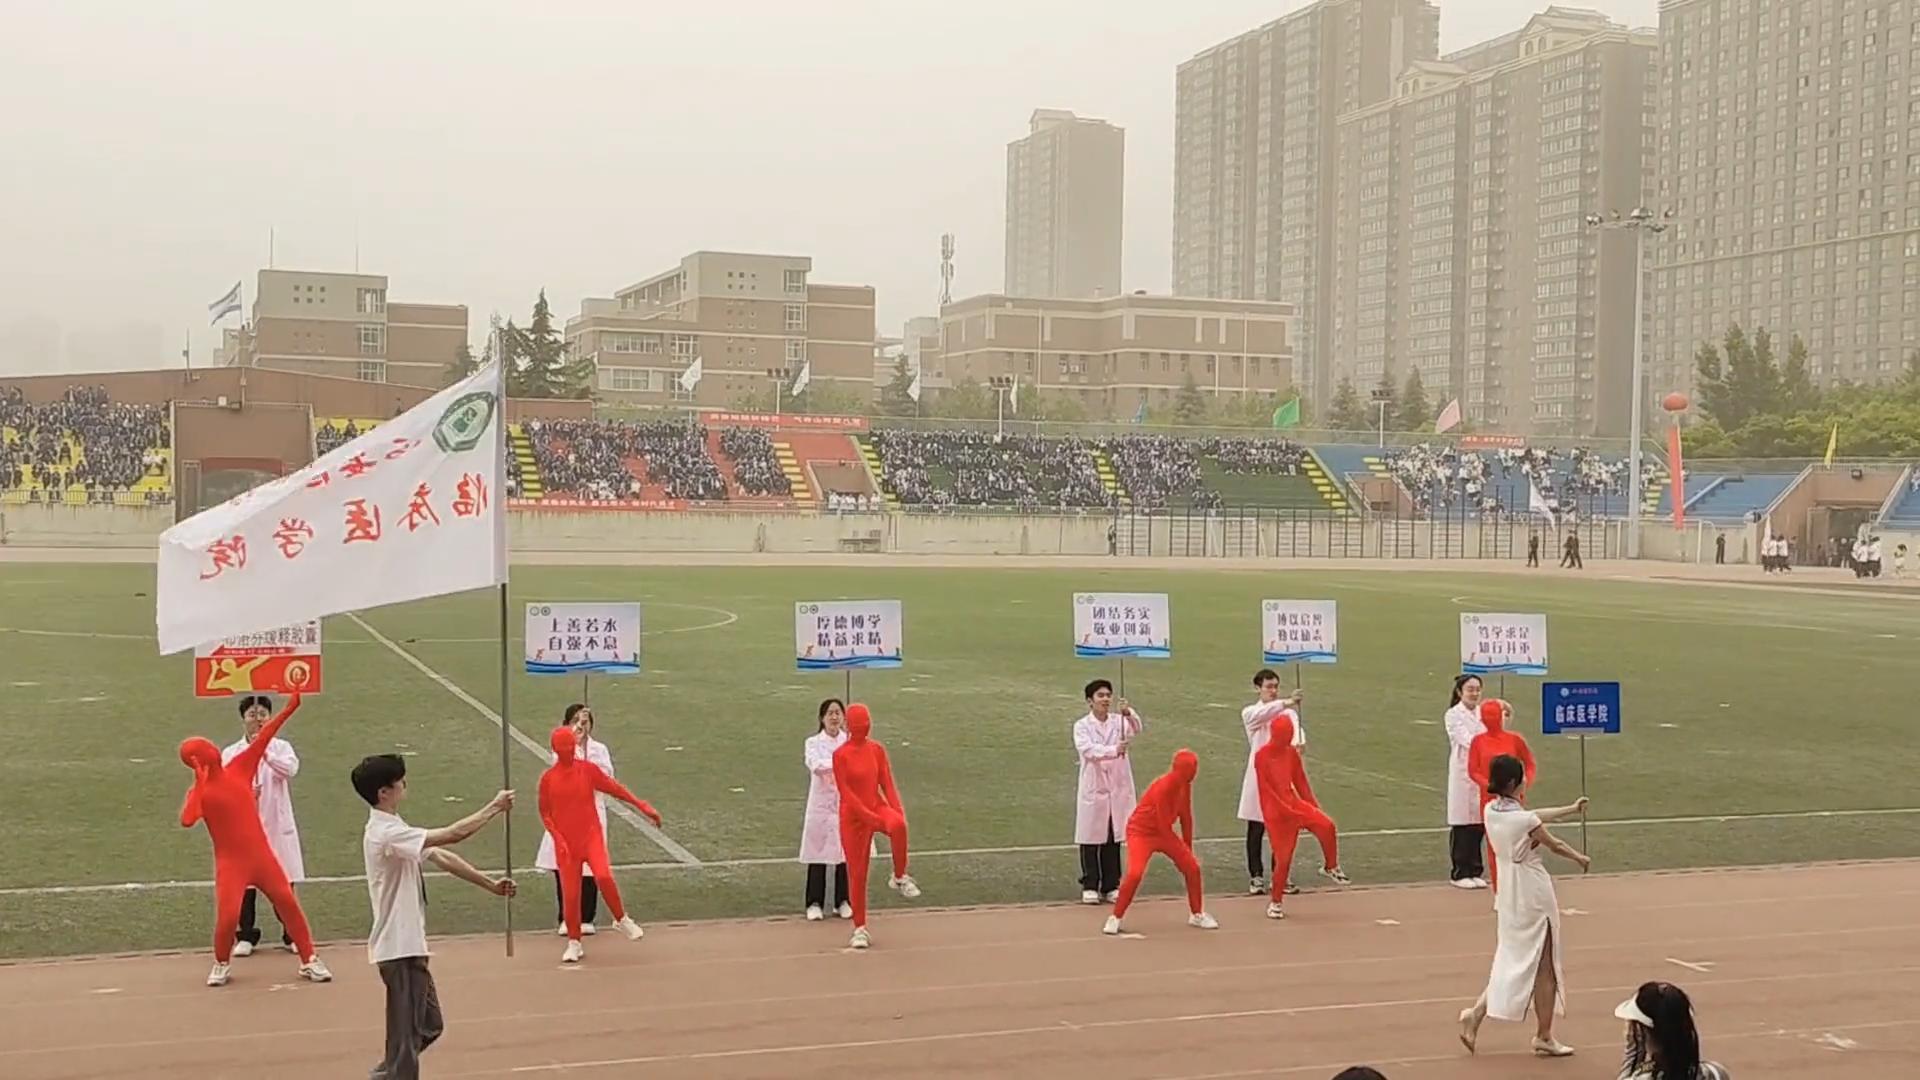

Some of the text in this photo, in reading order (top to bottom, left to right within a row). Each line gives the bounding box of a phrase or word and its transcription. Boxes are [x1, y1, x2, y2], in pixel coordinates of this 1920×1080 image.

[1093, 606, 1150, 620] 团结务实
[549, 618, 617, 632] 上善若水
[818, 614, 881, 629] 厚德博学
[1094, 622, 1151, 635] 敬业创新
[818, 632, 881, 646] 精益求精
[1479, 625, 1528, 639] 笃学求是
[549, 636, 617, 651] 自强不息
[1556, 704, 1608, 723] 临床医学院
